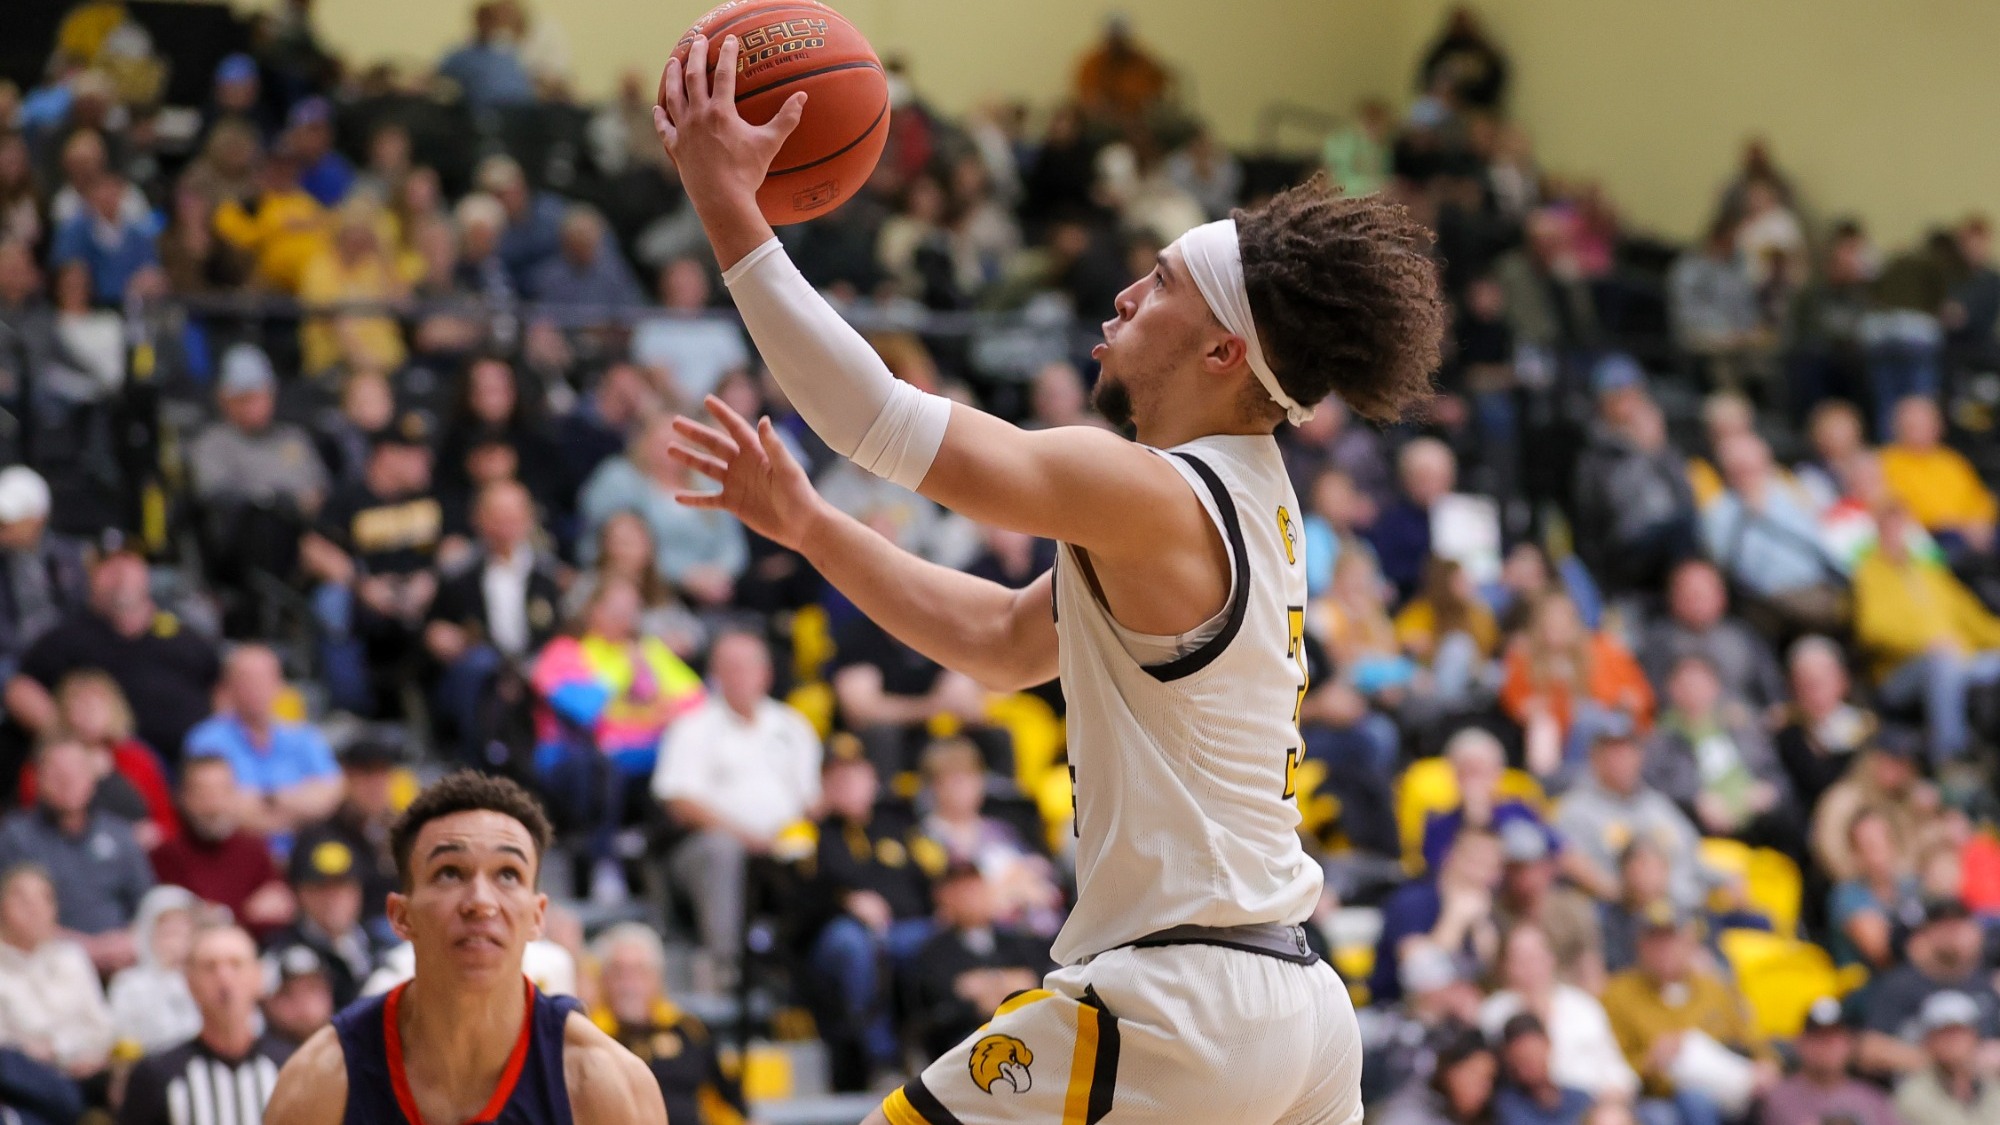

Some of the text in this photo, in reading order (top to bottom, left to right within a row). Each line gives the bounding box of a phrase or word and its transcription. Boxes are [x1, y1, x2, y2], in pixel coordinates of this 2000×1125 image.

[737, 18, 828, 54] GACY
[744, 61, 774, 79] OFFICIAL
[774, 55, 793, 66] GAME
